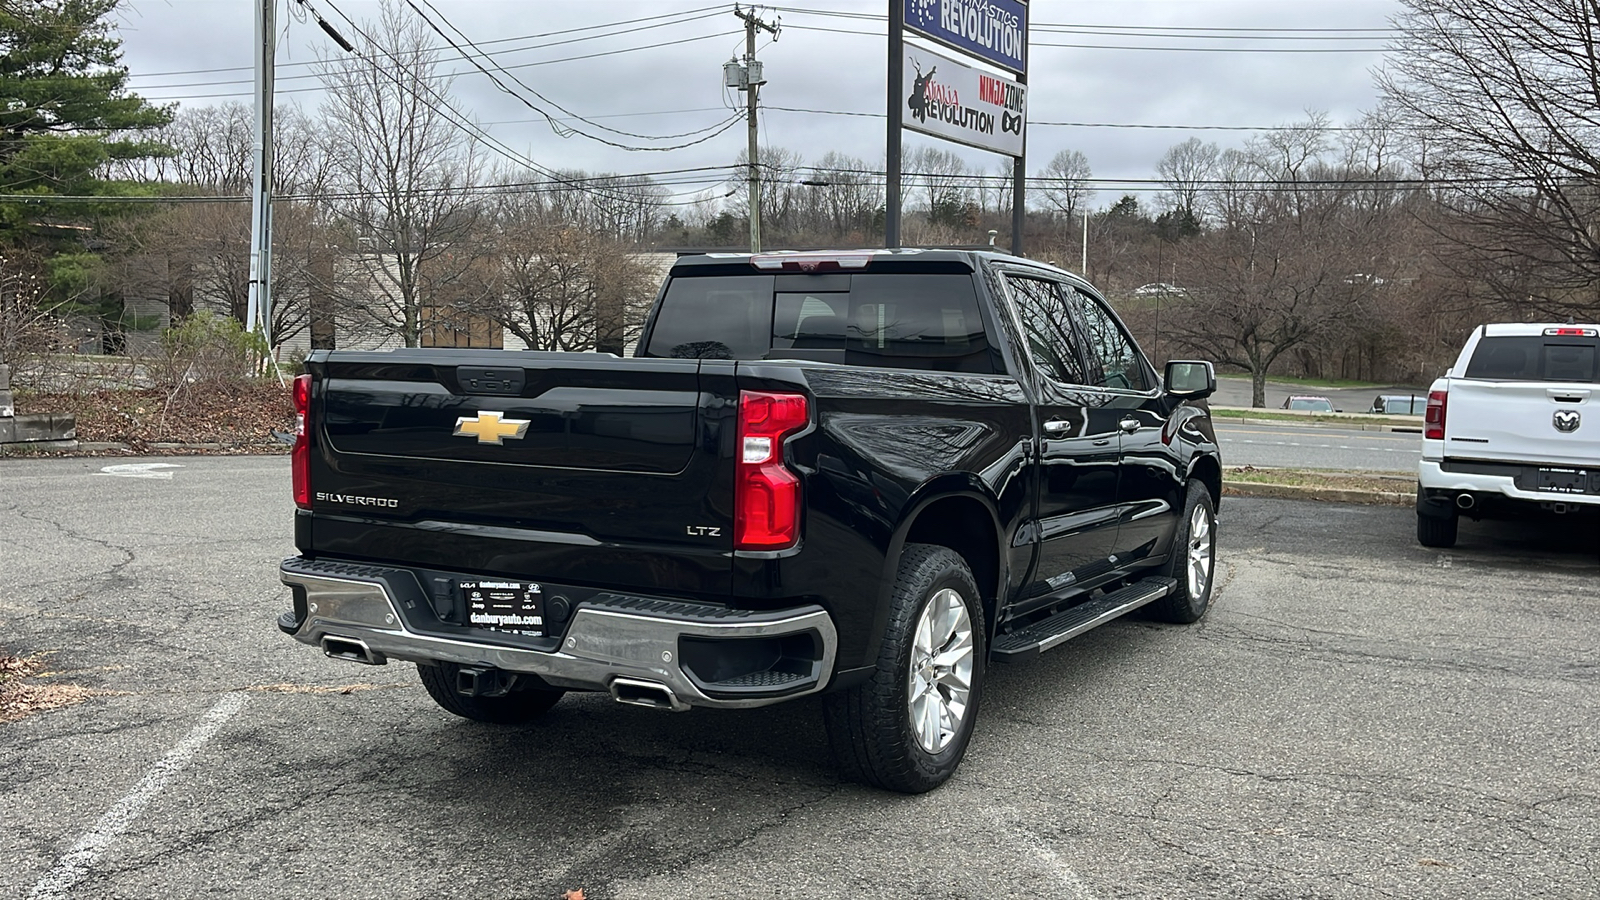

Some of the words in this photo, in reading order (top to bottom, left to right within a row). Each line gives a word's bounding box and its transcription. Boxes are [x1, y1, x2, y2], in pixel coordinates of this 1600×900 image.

[941, 0, 1022, 61] REVOLUTION
[924, 95, 995, 135] REVOLUTION
[316, 492, 399, 508] SILVERADO
[686, 525, 721, 537] LTZ
[470, 611, 543, 627] danburyauto.com
